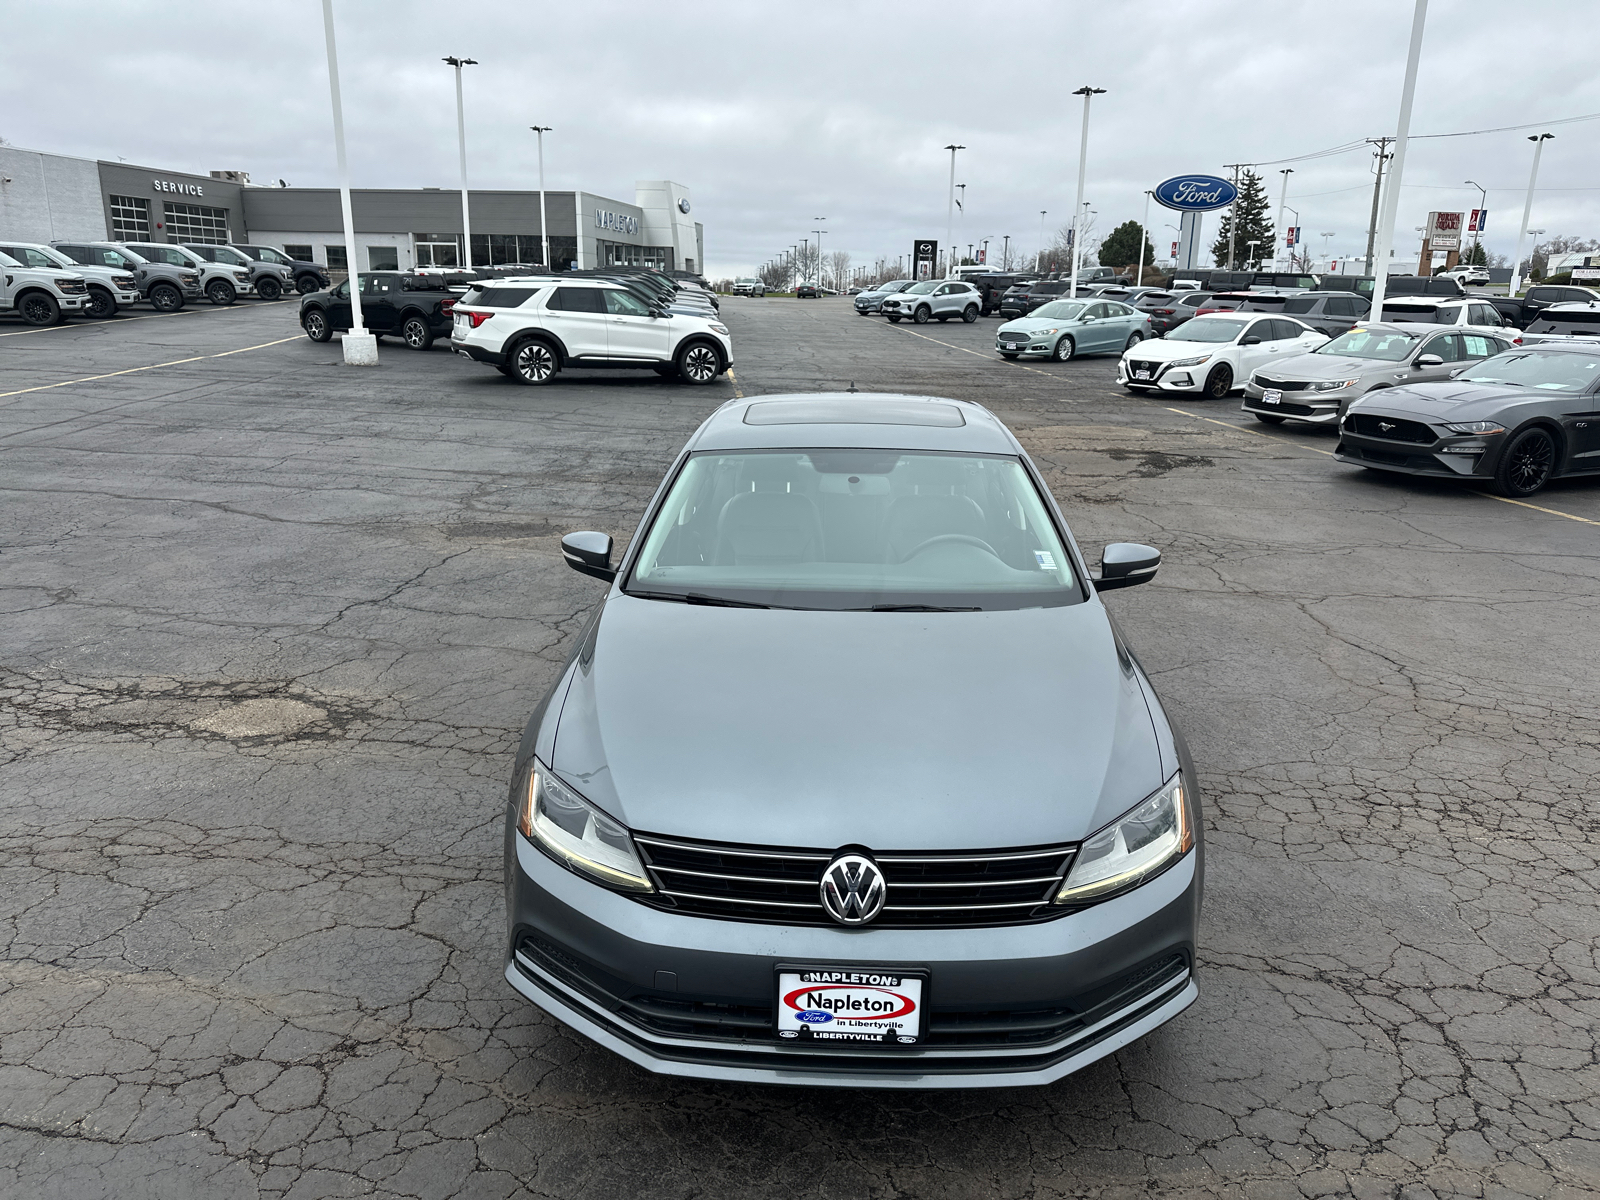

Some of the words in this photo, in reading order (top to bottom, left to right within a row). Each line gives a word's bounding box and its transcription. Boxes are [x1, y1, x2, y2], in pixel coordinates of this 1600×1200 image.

[154, 180, 203, 196] SERVICE
[1173, 181, 1222, 203] Ford
[595, 209, 638, 235] NAPLETON
[809, 972, 893, 986] NAPLETON
[806, 992, 894, 1013] Napleton
[803, 1012, 826, 1022] Ford
[849, 1020, 904, 1029] Libertyville
[813, 1032, 883, 1041] LIBERTYVILLE
